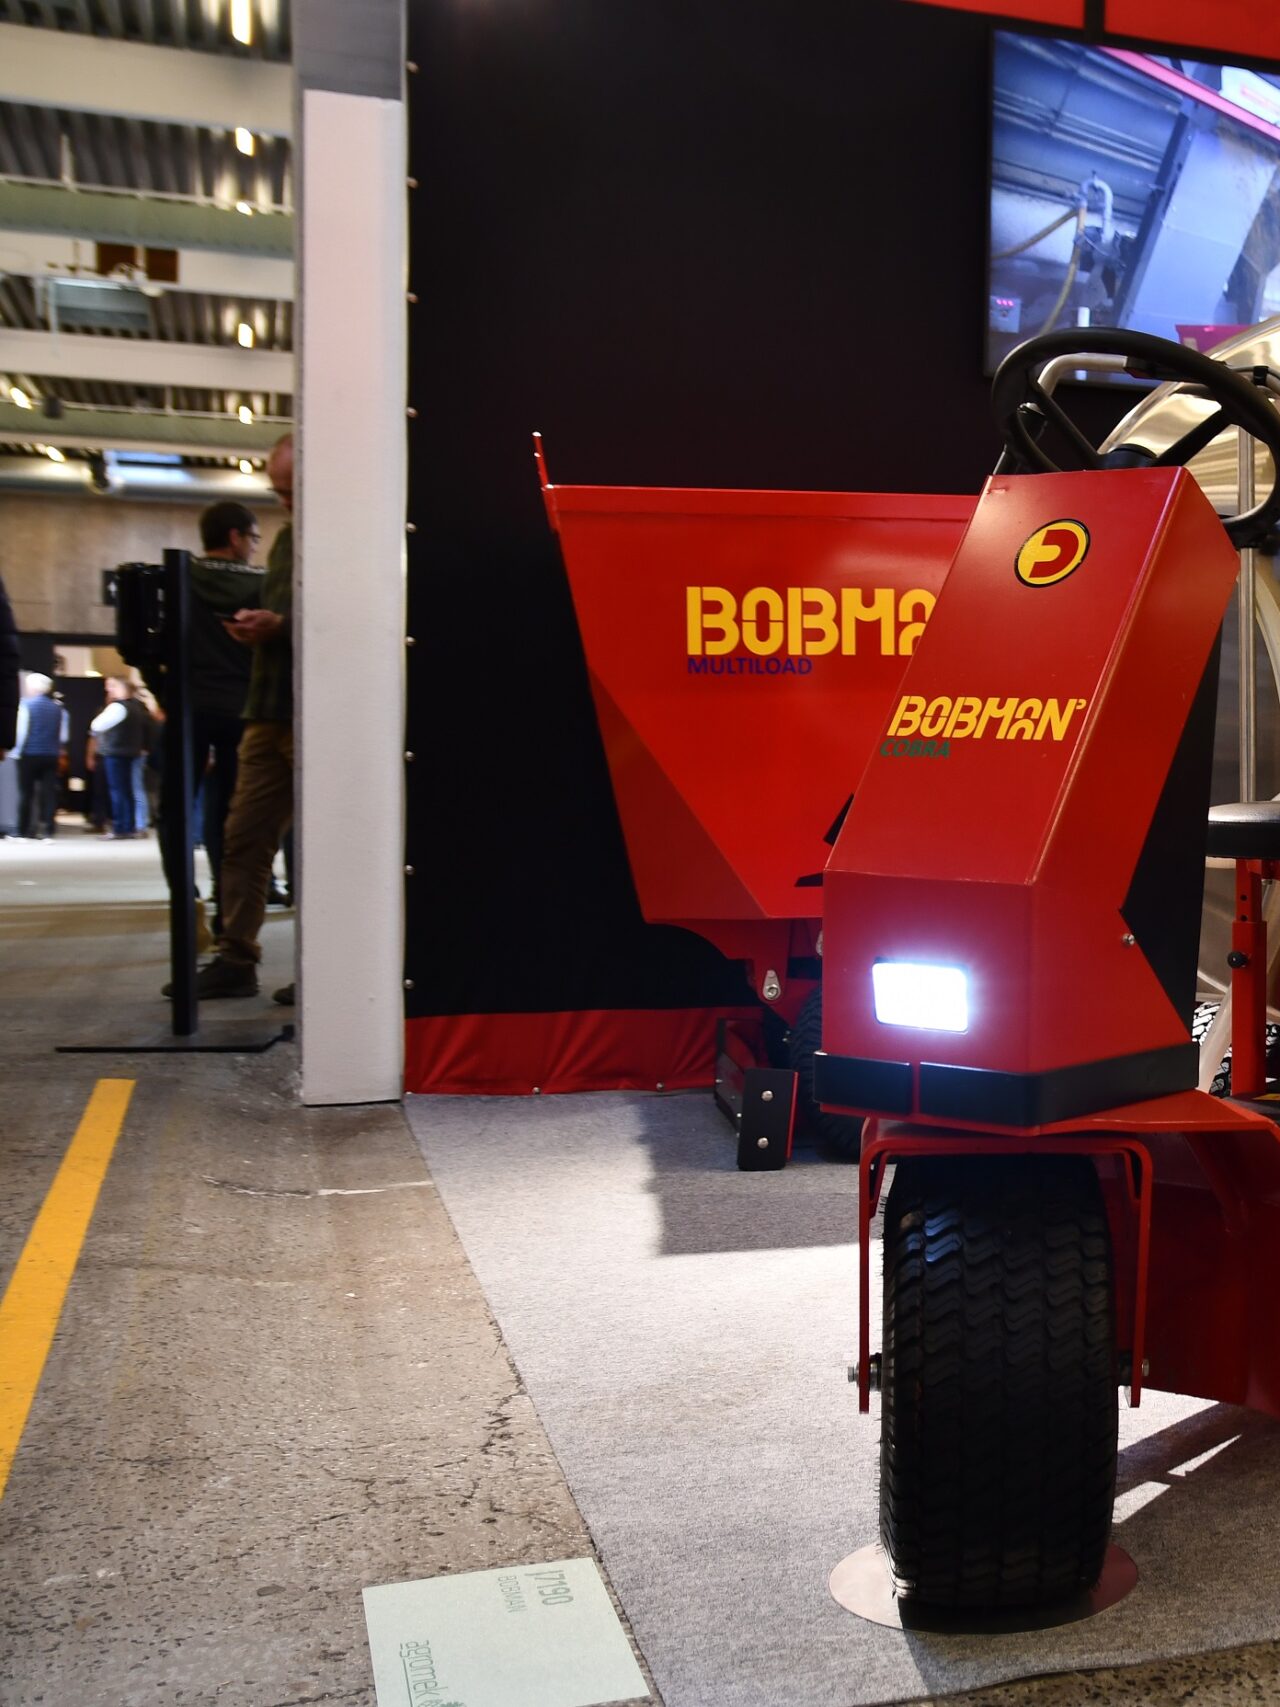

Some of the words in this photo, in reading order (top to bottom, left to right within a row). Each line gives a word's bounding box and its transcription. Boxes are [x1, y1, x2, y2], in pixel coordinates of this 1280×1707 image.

[686, 586, 937, 656] BOBMA
[687, 657, 813, 675] MULTILOAD
[886, 695, 1078, 741] BOBMAN
[879, 738, 950, 758] COBRA
[497, 1575, 528, 1613] BOBMAN
[399, 1639, 449, 1699] agromek
